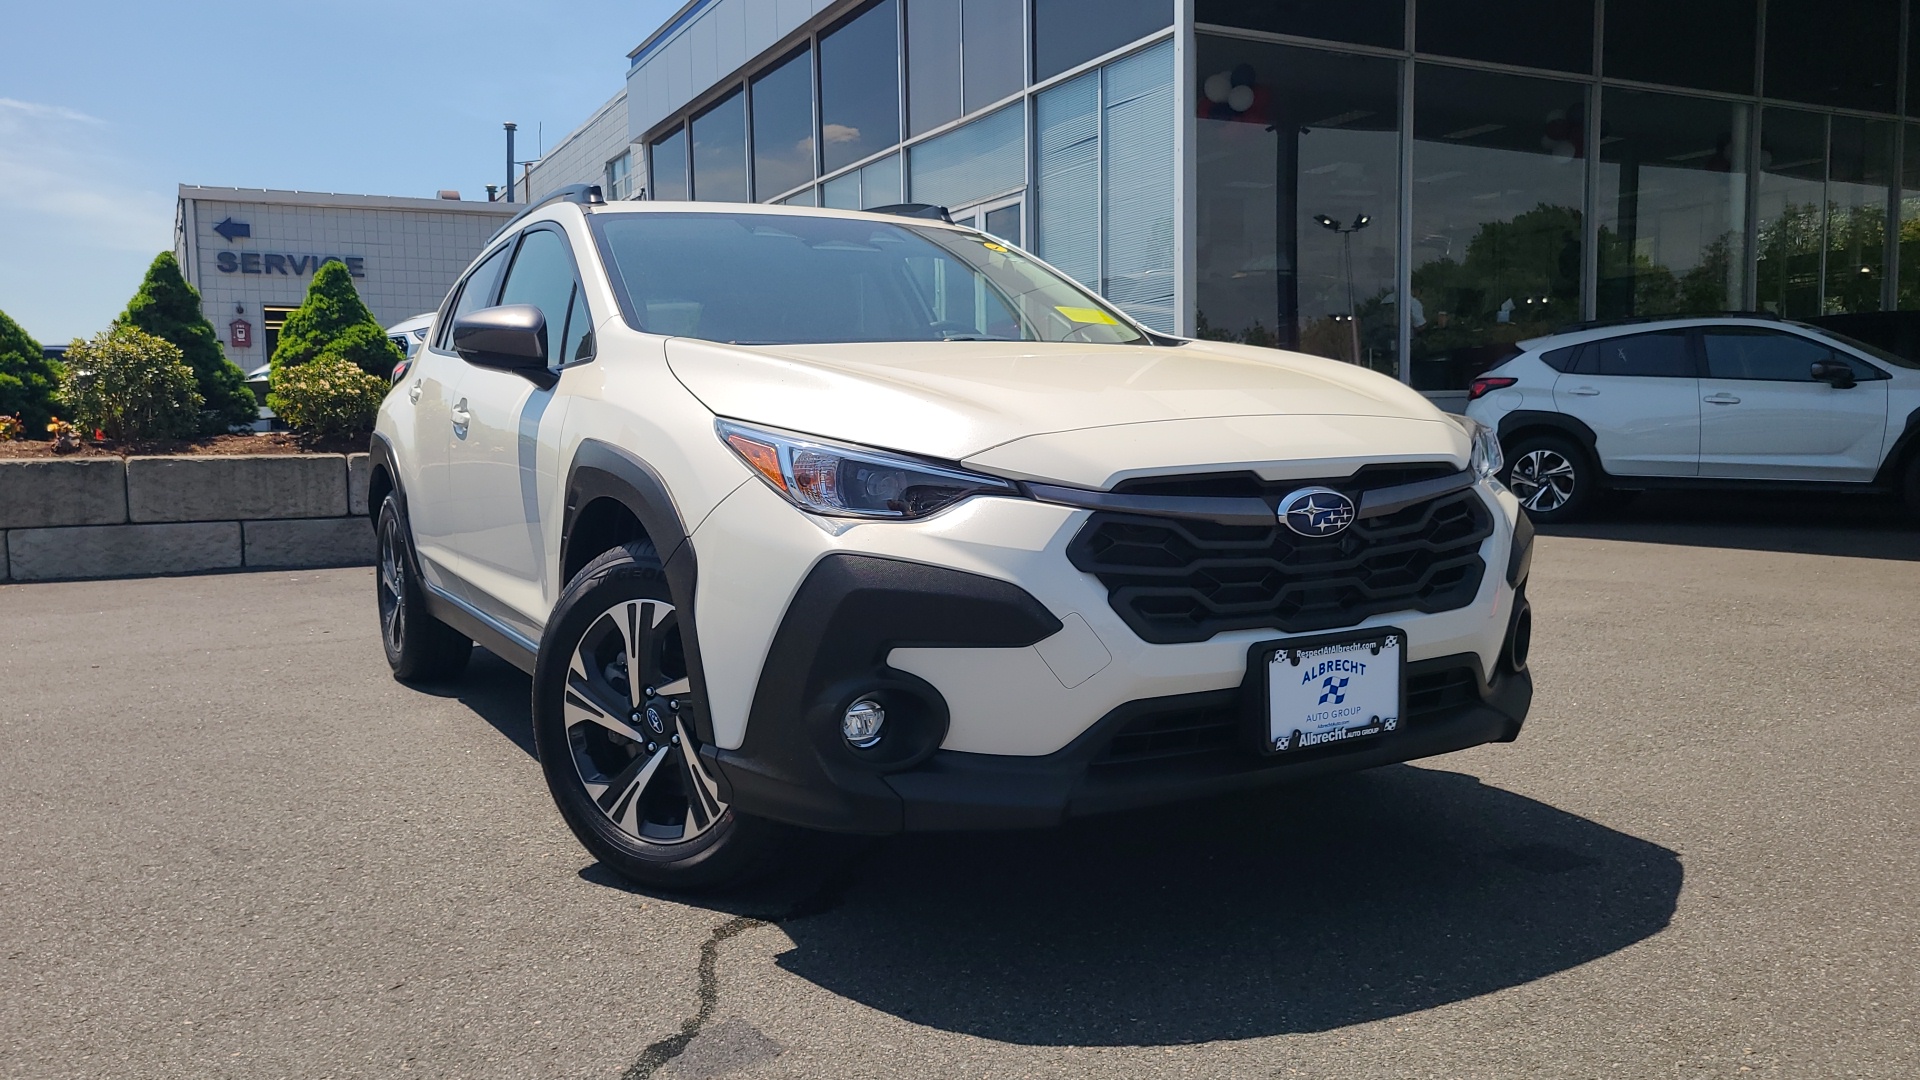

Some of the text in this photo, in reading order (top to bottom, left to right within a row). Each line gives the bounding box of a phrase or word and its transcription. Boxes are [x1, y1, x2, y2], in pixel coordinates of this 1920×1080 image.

[1302, 660, 1366, 685] ALBRECHT
[1306, 706, 1361, 723] AUTO GROUP
[1298, 727, 1380, 747] Albrecht AUTO GROUP
